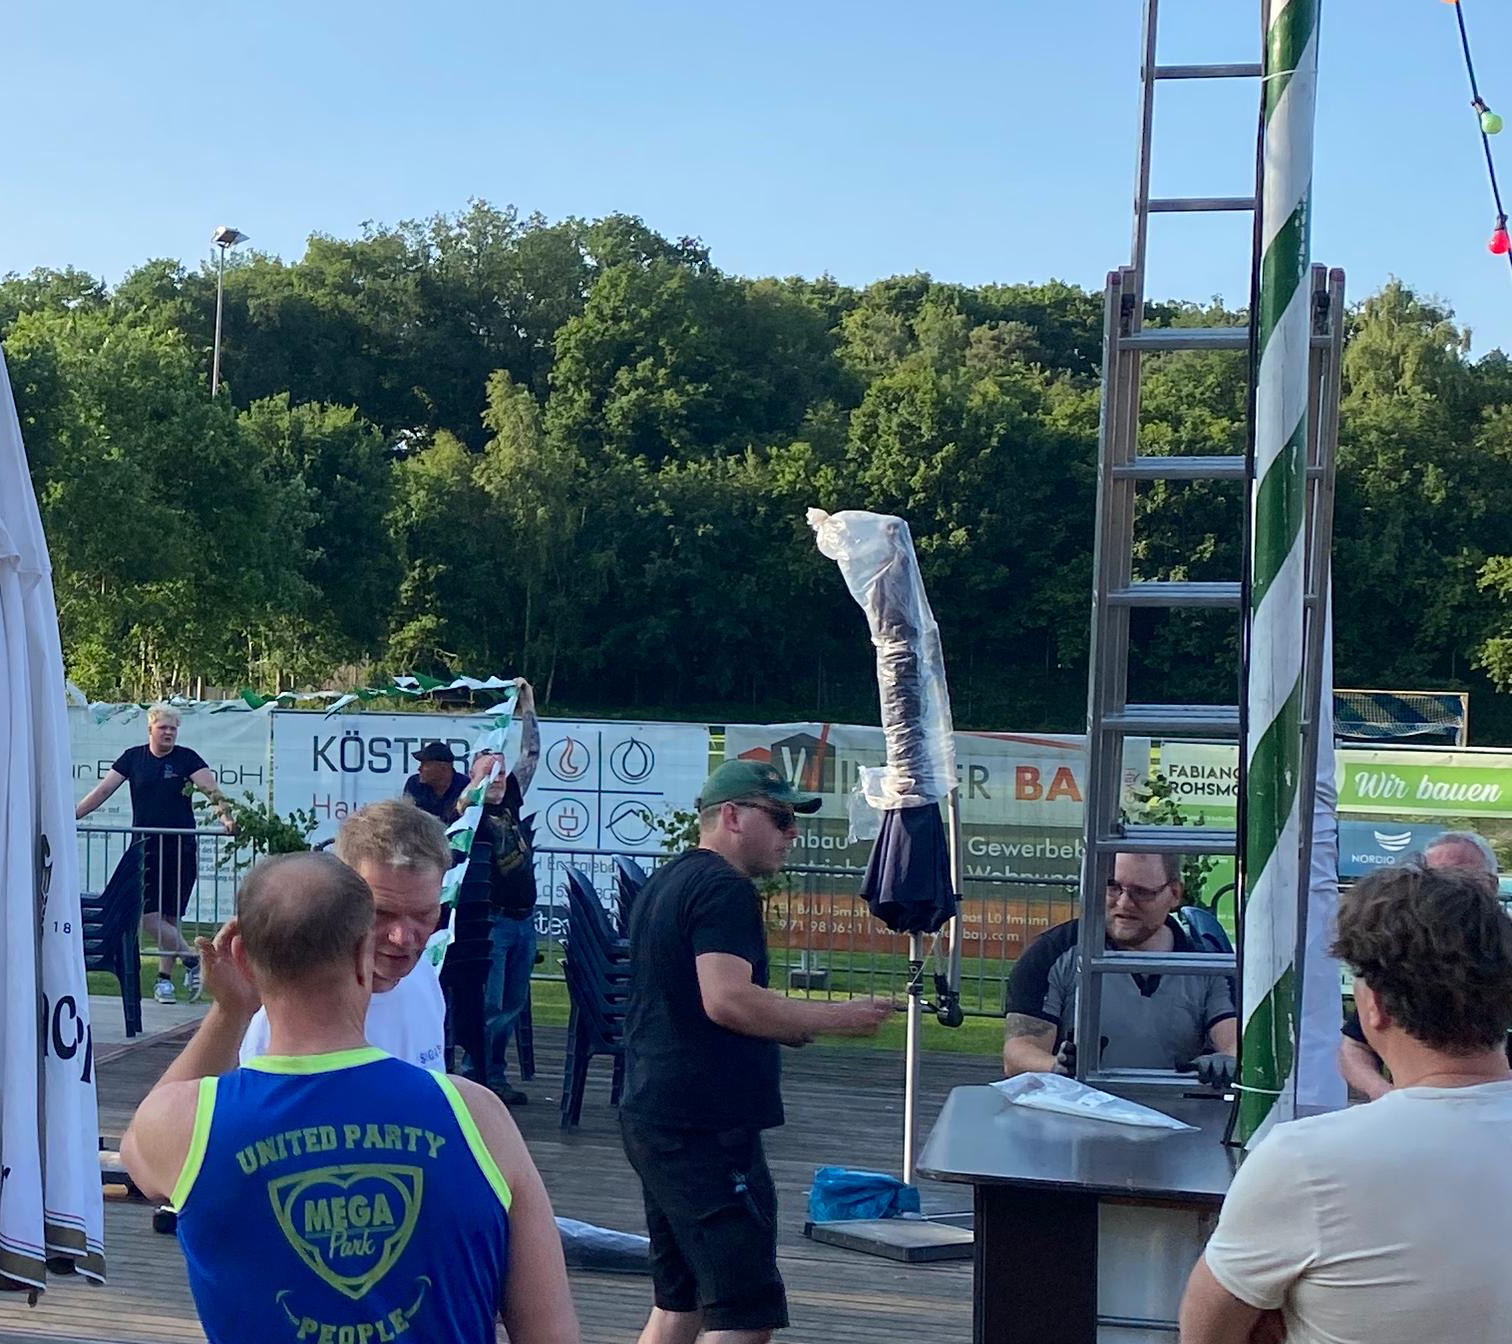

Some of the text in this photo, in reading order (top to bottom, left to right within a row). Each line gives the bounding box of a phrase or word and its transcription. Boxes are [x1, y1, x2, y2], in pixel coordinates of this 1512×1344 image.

[1354, 771, 1503, 803] Wir bauen
[235, 1123, 446, 1176] UNITED PARTY
[304, 1192, 395, 1233] MEGA
[328, 1229, 376, 1260] Park
